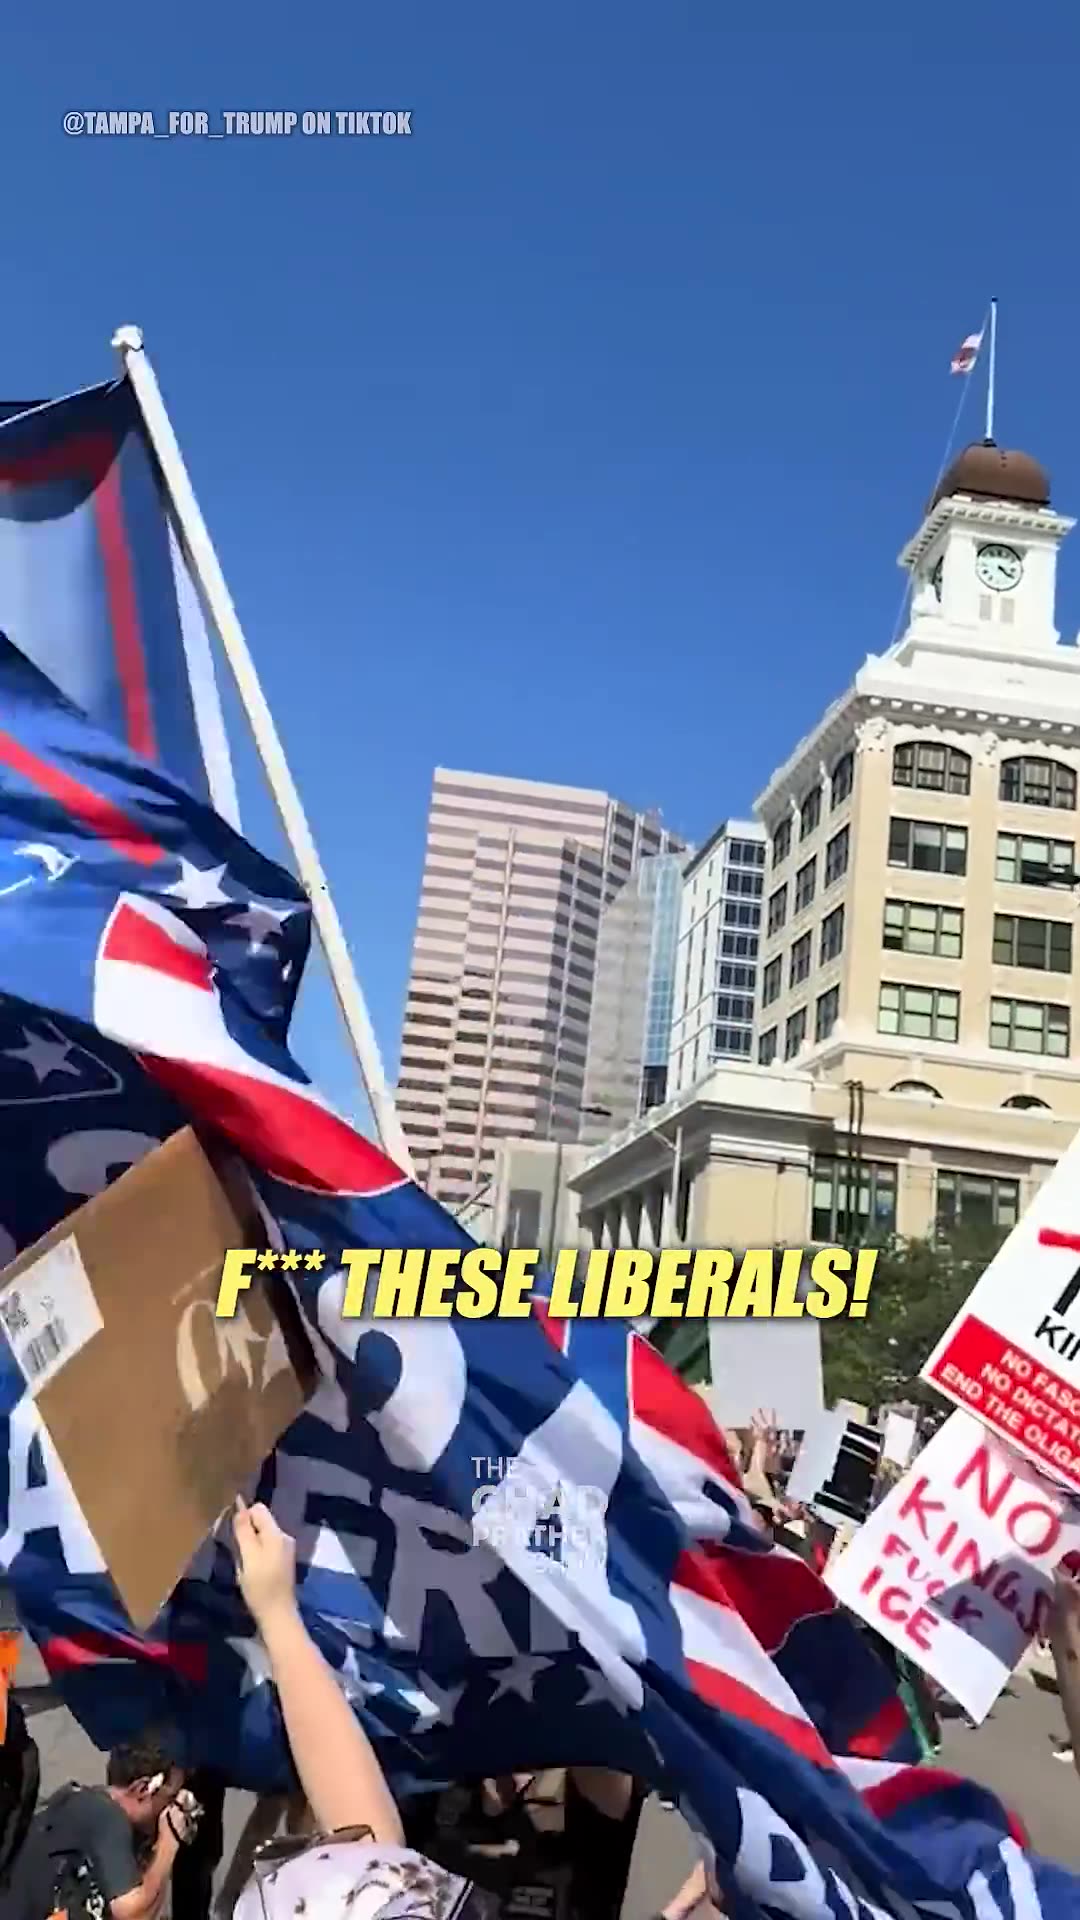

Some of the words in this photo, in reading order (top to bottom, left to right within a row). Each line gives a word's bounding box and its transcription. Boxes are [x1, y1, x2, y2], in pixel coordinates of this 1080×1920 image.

[940, 1361, 984, 1400] END
[984, 1392, 1025, 1431] THE
[980, 1362, 1012, 1391] NO
[1000, 1349, 1032, 1379] NO
[953, 1444, 1062, 1557] NO
[859, 1564, 941, 1651] ICE
